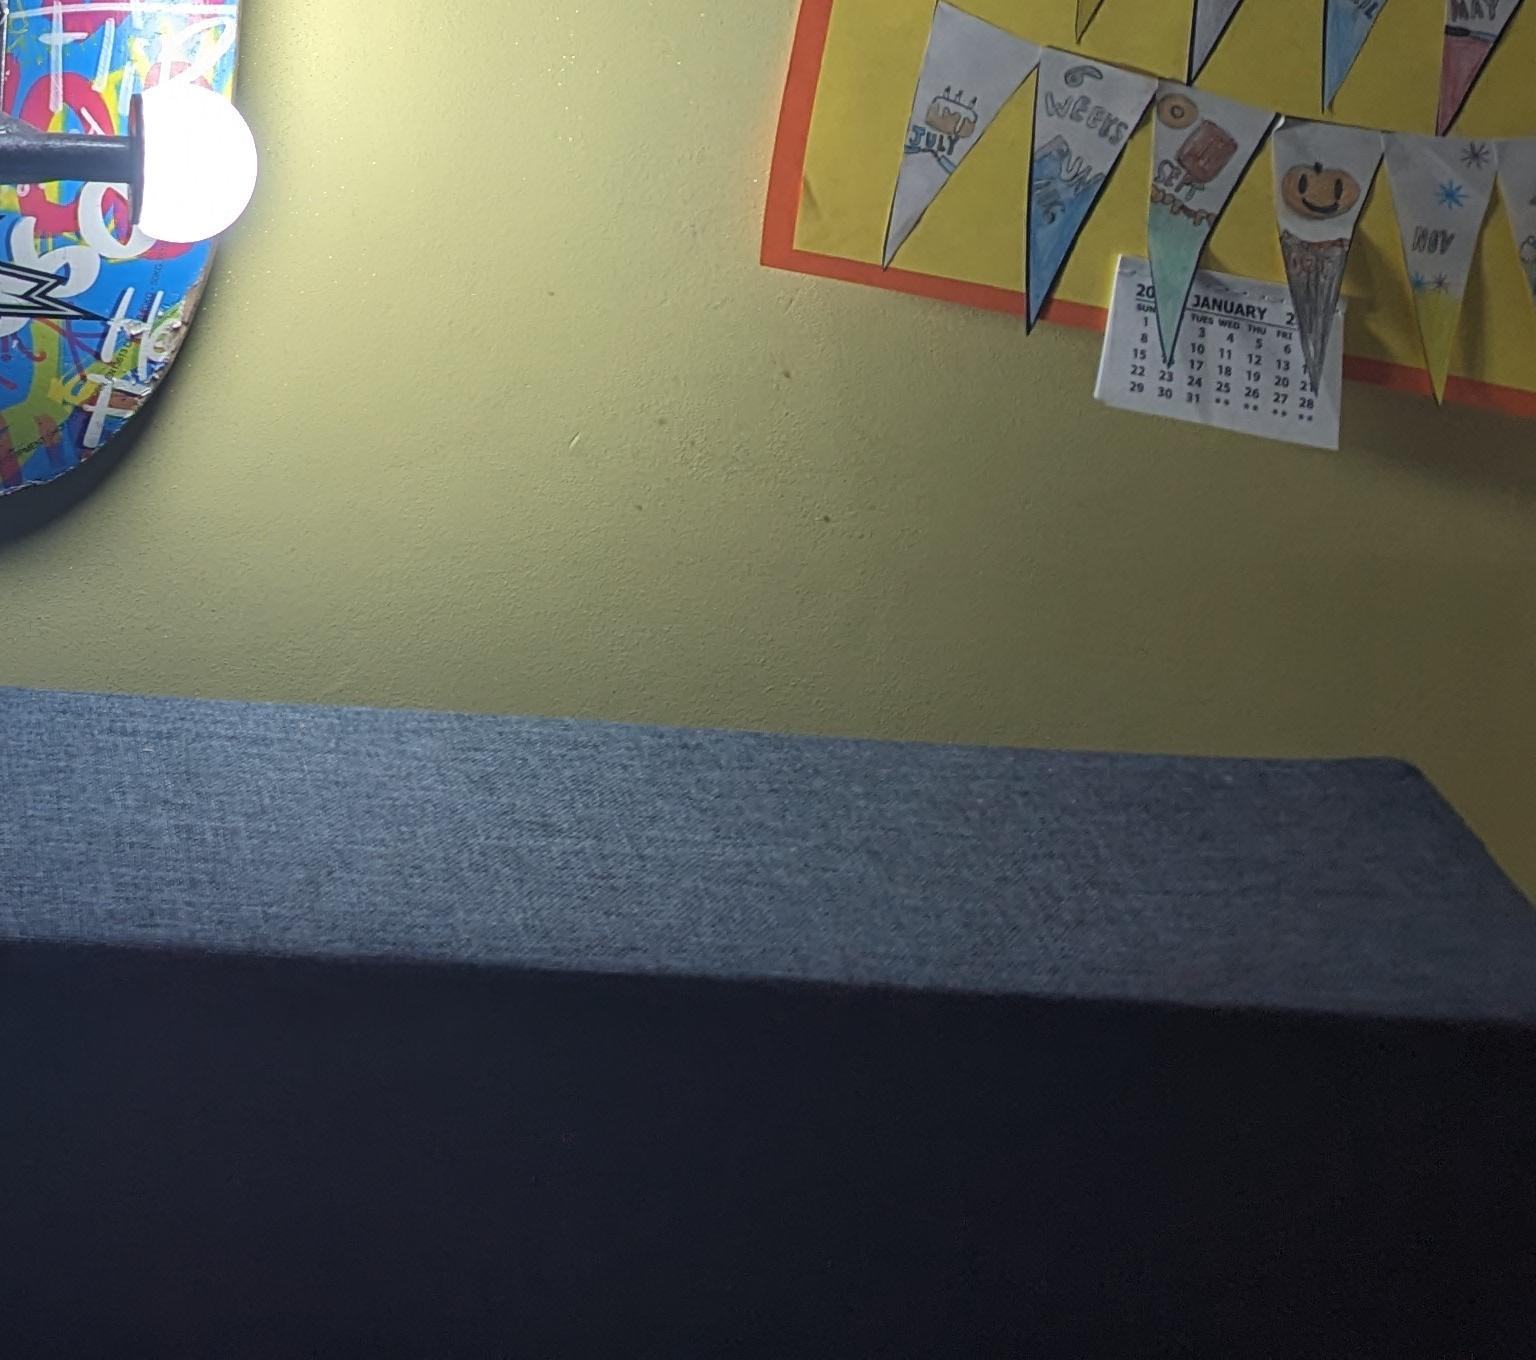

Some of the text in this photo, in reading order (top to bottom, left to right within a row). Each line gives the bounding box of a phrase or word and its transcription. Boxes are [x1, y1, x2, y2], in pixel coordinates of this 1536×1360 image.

[1044, 91, 1129, 146] WEEKS
[909, 125, 959, 156] JULY
[1412, 225, 1456, 255] NOV
[1192, 294, 1267, 320] JANUARY
[1190, 313, 1293, 340] TUES WED THU FRI
[1132, 349, 1289, 388] 15 17 18 19 20
[1191, 343, 1290, 371] 10 11 12 13
[1129, 382, 1200, 404] 29 30 31
[1130, 365, 1313, 409] 22 23 24 25 26 27 28
